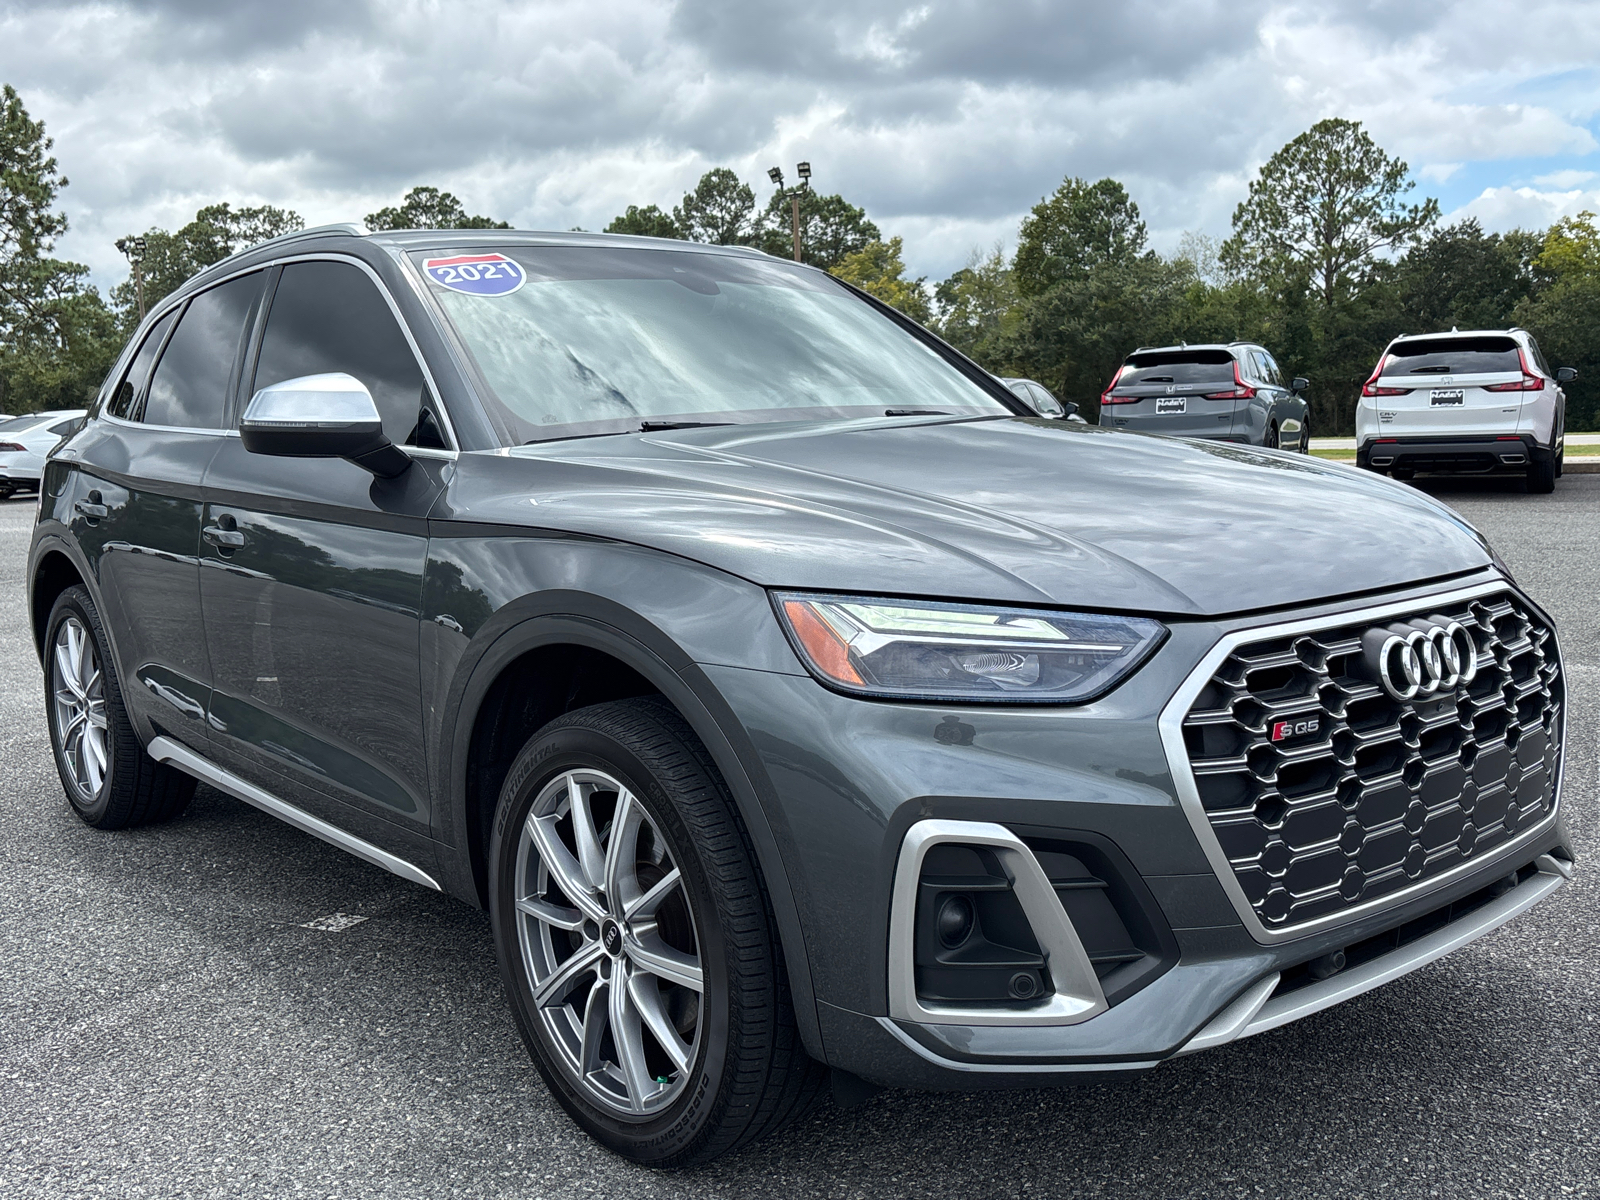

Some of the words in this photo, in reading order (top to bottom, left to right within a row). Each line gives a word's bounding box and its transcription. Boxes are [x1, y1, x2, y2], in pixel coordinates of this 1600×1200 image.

[436, 262, 519, 284] 2021
[1279, 719, 1320, 738] SQ5
[497, 742, 561, 837] CONTINENTAL
[648, 781, 678, 821] CROSS
